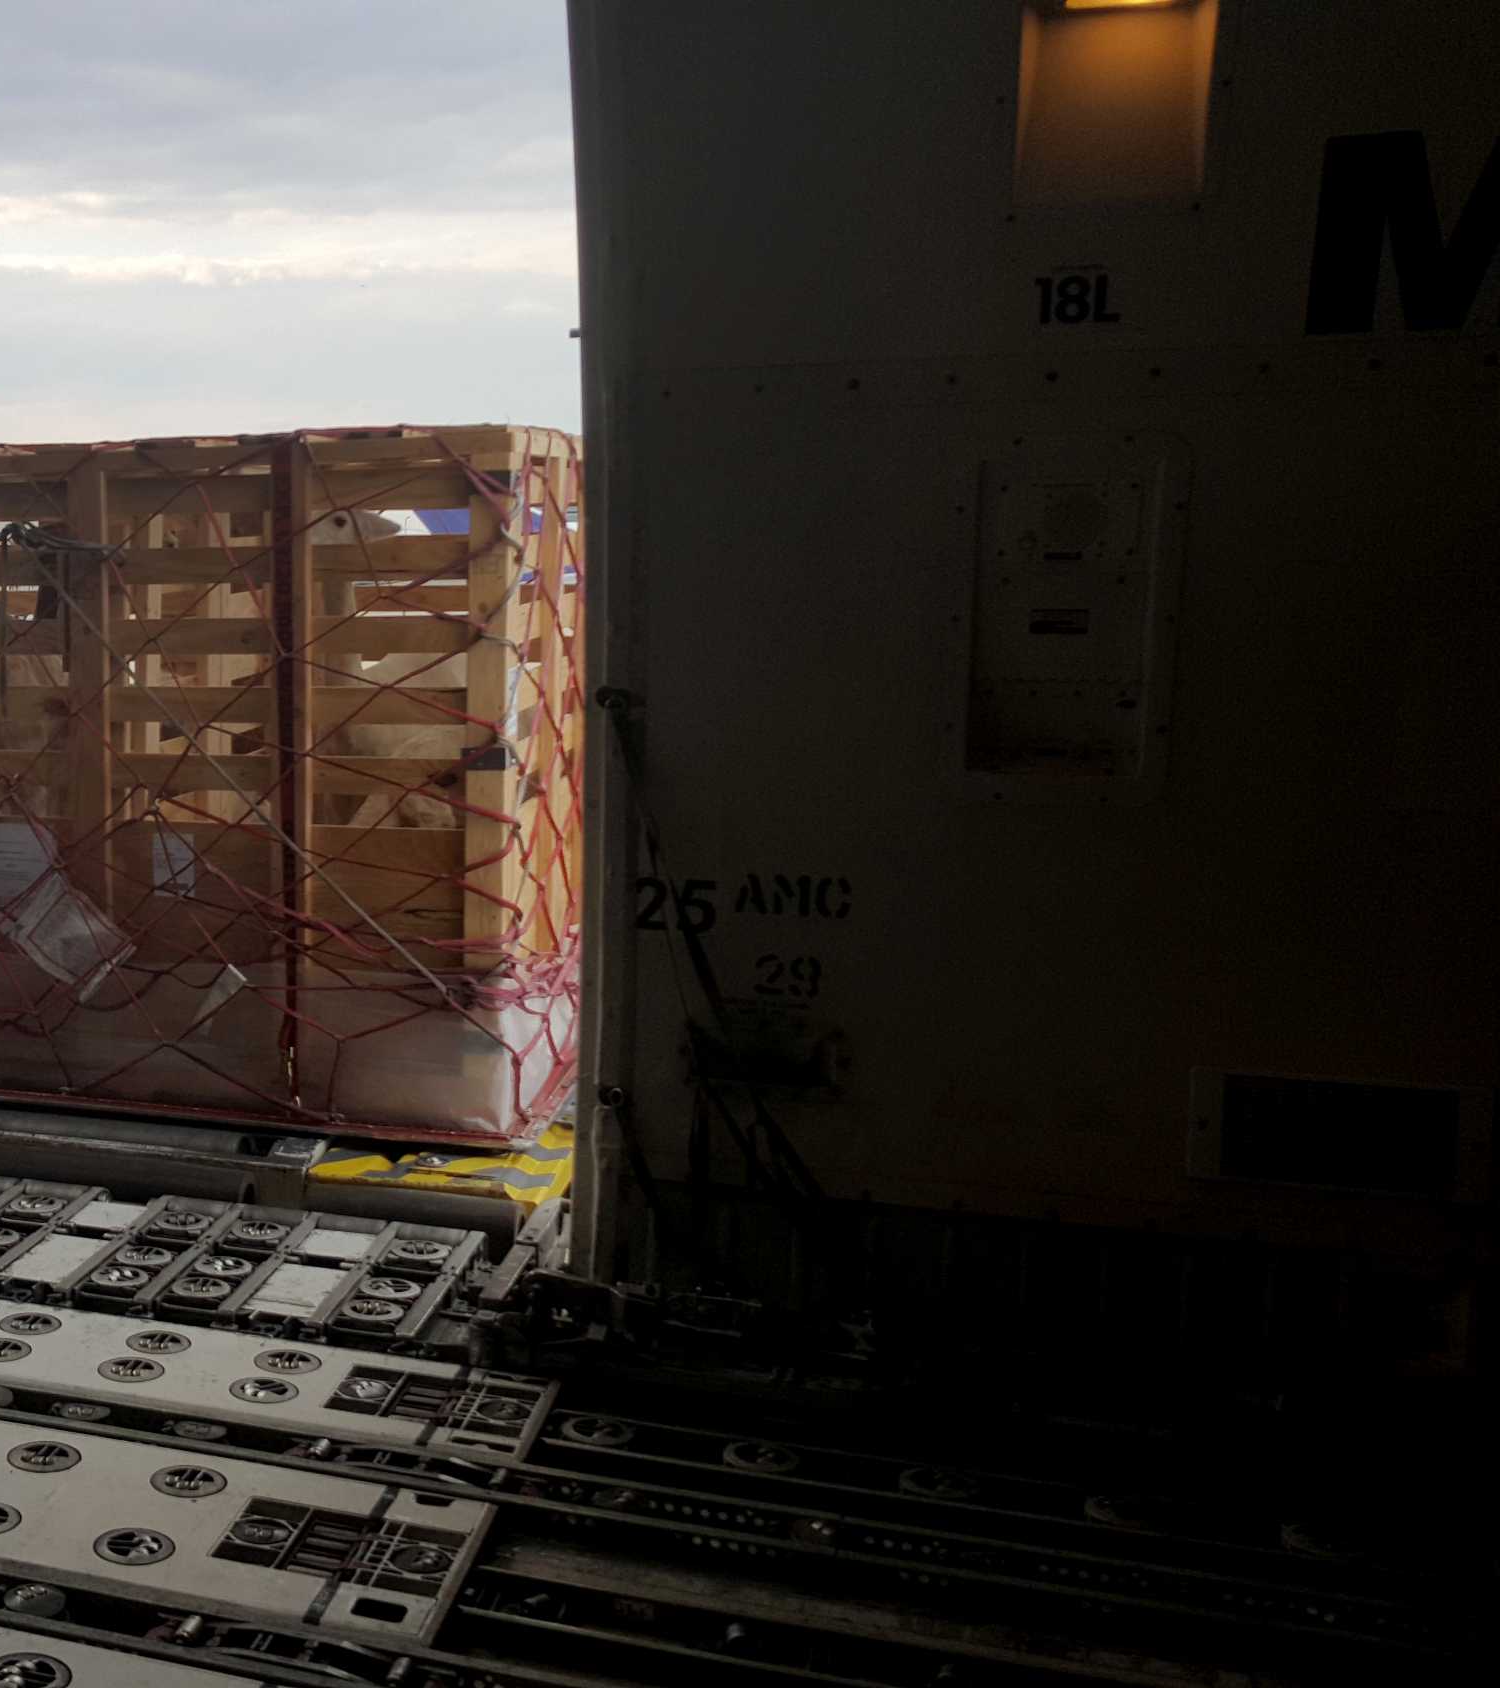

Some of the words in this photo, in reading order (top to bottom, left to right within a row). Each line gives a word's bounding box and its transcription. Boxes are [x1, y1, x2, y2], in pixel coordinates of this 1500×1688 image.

[1034, 273, 1122, 325] 18L
[635, 876, 717, 935] 25
[734, 873, 852, 919] AMC
[753, 953, 822, 998] 29
